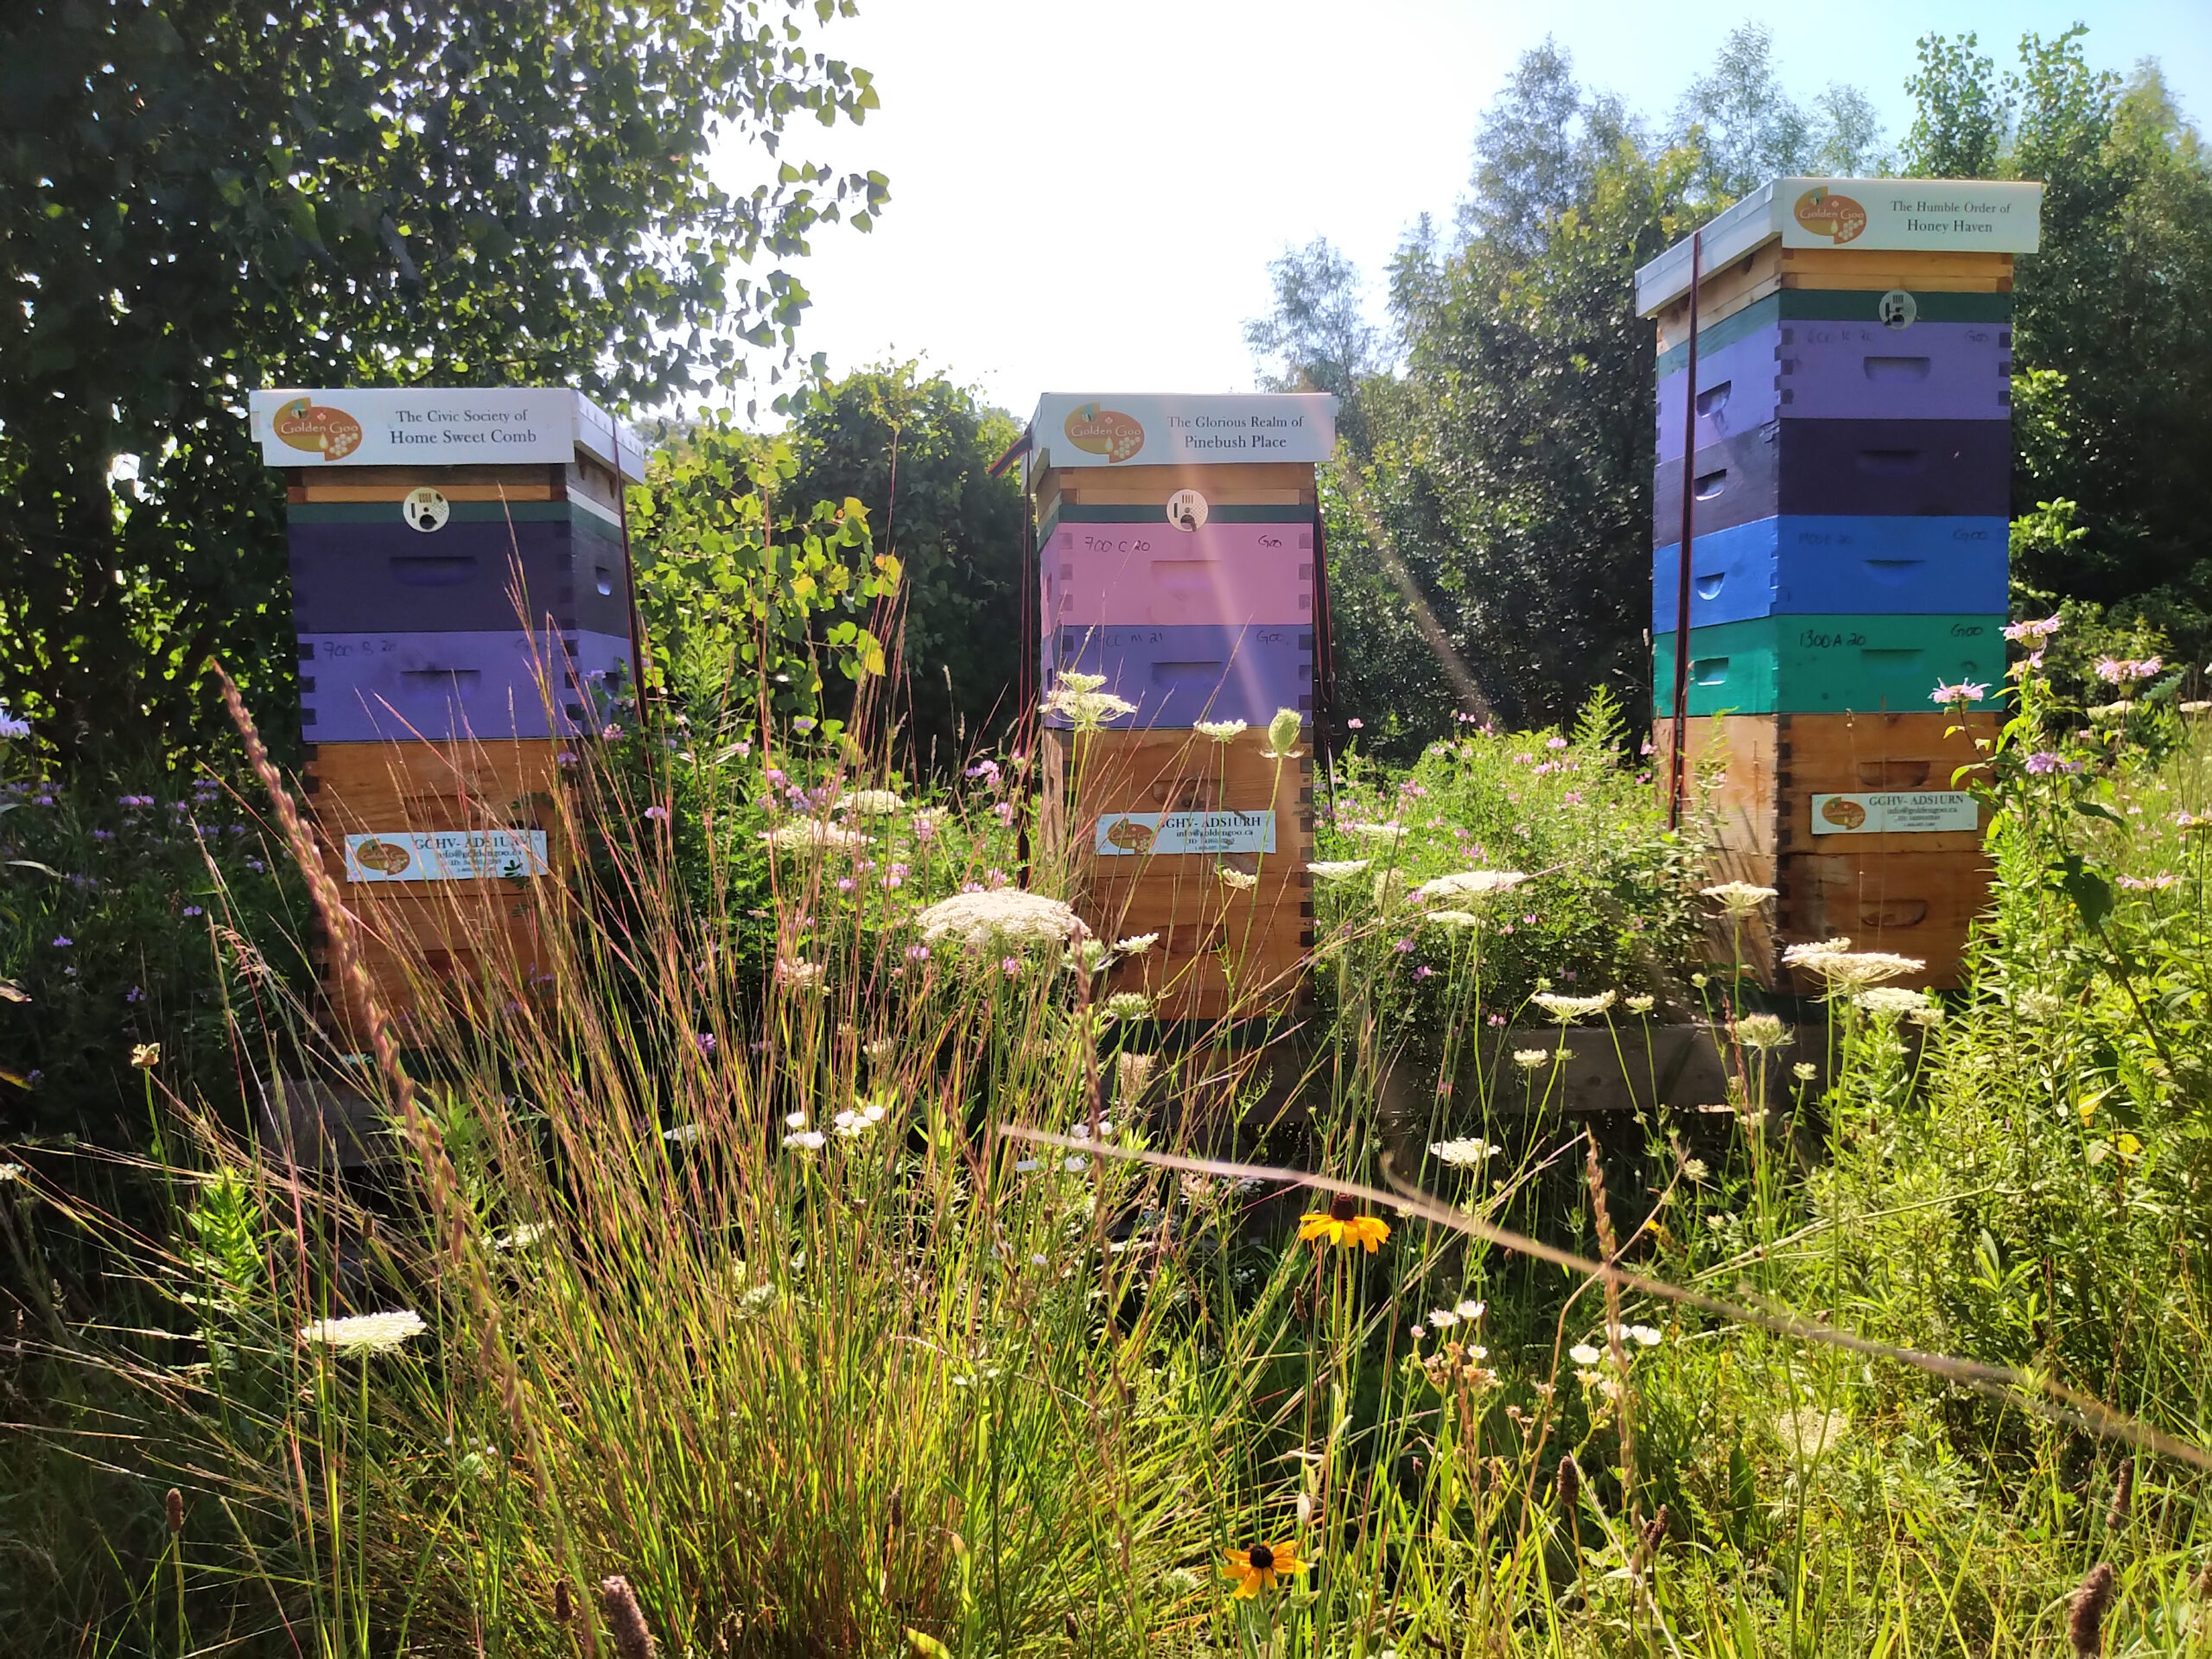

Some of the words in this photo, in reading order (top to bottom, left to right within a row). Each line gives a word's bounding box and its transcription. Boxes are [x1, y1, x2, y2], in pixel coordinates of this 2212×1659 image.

[1800, 208, 1838, 219] Golden
[1840, 209, 1864, 219] Goo
[1891, 200, 1912, 213] The
[1916, 201, 1960, 213] Humble
[1964, 203, 1995, 214] Order
[1999, 203, 2012, 214] of
[1907, 219, 1948, 234] Honey
[1953, 220, 1993, 232] Haven
[396, 410, 423, 423] The
[427, 410, 461, 423] Civic
[464, 409, 510, 426] Society
[514, 409, 528, 422] of
[1168, 416, 1192, 429] The
[1195, 416, 1246, 429] Glorious
[1251, 416, 1287, 429] Realm
[1291, 416, 1305, 428] of
[281, 421, 327, 435] Golden
[329, 423, 359, 434] Goo
[1071, 425, 1112, 437] Golden
[1116, 426, 1141, 437] Goo
[391, 430, 438, 444] Home
[442, 429, 486, 444] Sweet
[490, 429, 537, 443] Comb
[1185, 435, 1246, 448] Pinebush
[1252, 435, 1287, 448] Place
[1258, 535, 1282, 549] Goo
[1953, 529, 1987, 543] Goo
[1084, 536, 1113, 553] 700
[1950, 623, 1984, 638] Goo
[1847, 633, 1866, 646] 20
[1160, 817, 1198, 829] GHV-
